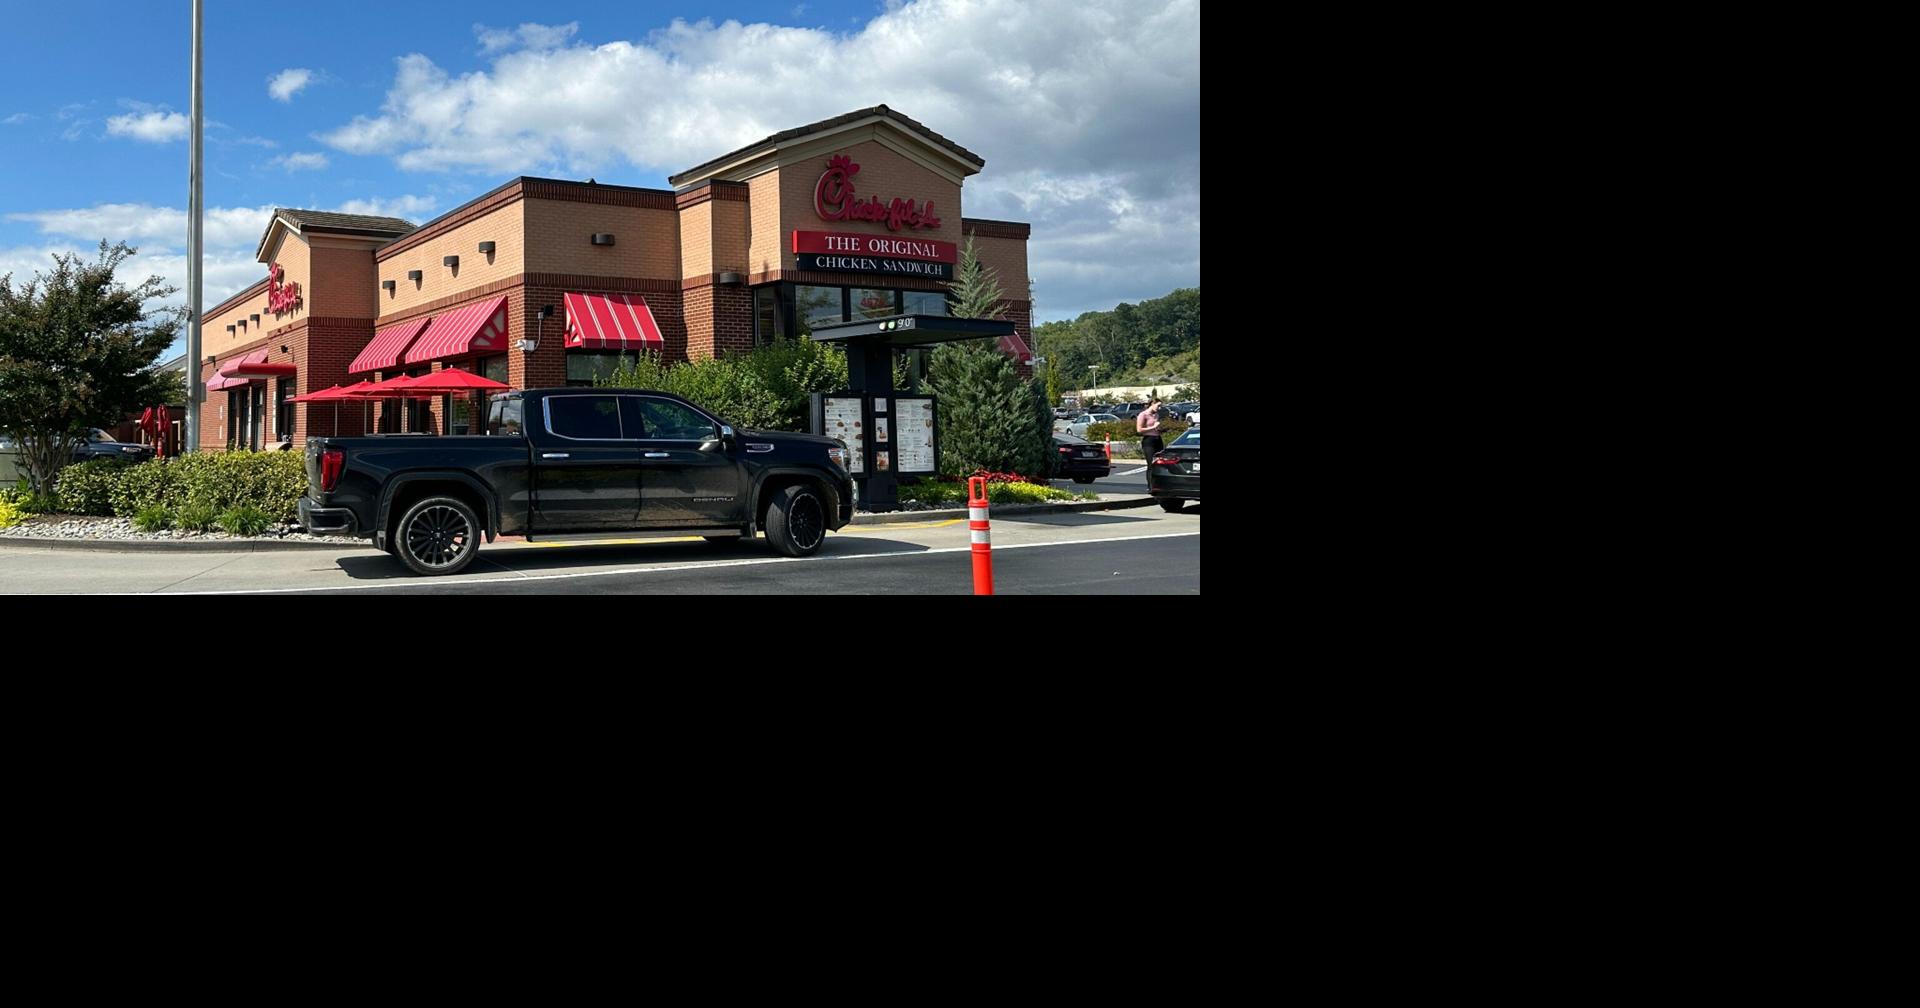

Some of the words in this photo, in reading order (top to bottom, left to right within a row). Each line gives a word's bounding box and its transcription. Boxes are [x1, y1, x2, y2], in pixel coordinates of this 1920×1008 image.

[814, 154, 942, 232] Chick-fil-A
[825, 236, 861, 251] THE
[868, 238, 939, 257] ORIGINAL
[815, 255, 877, 270] CHICKEN
[883, 259, 943, 276] SANDWICH
